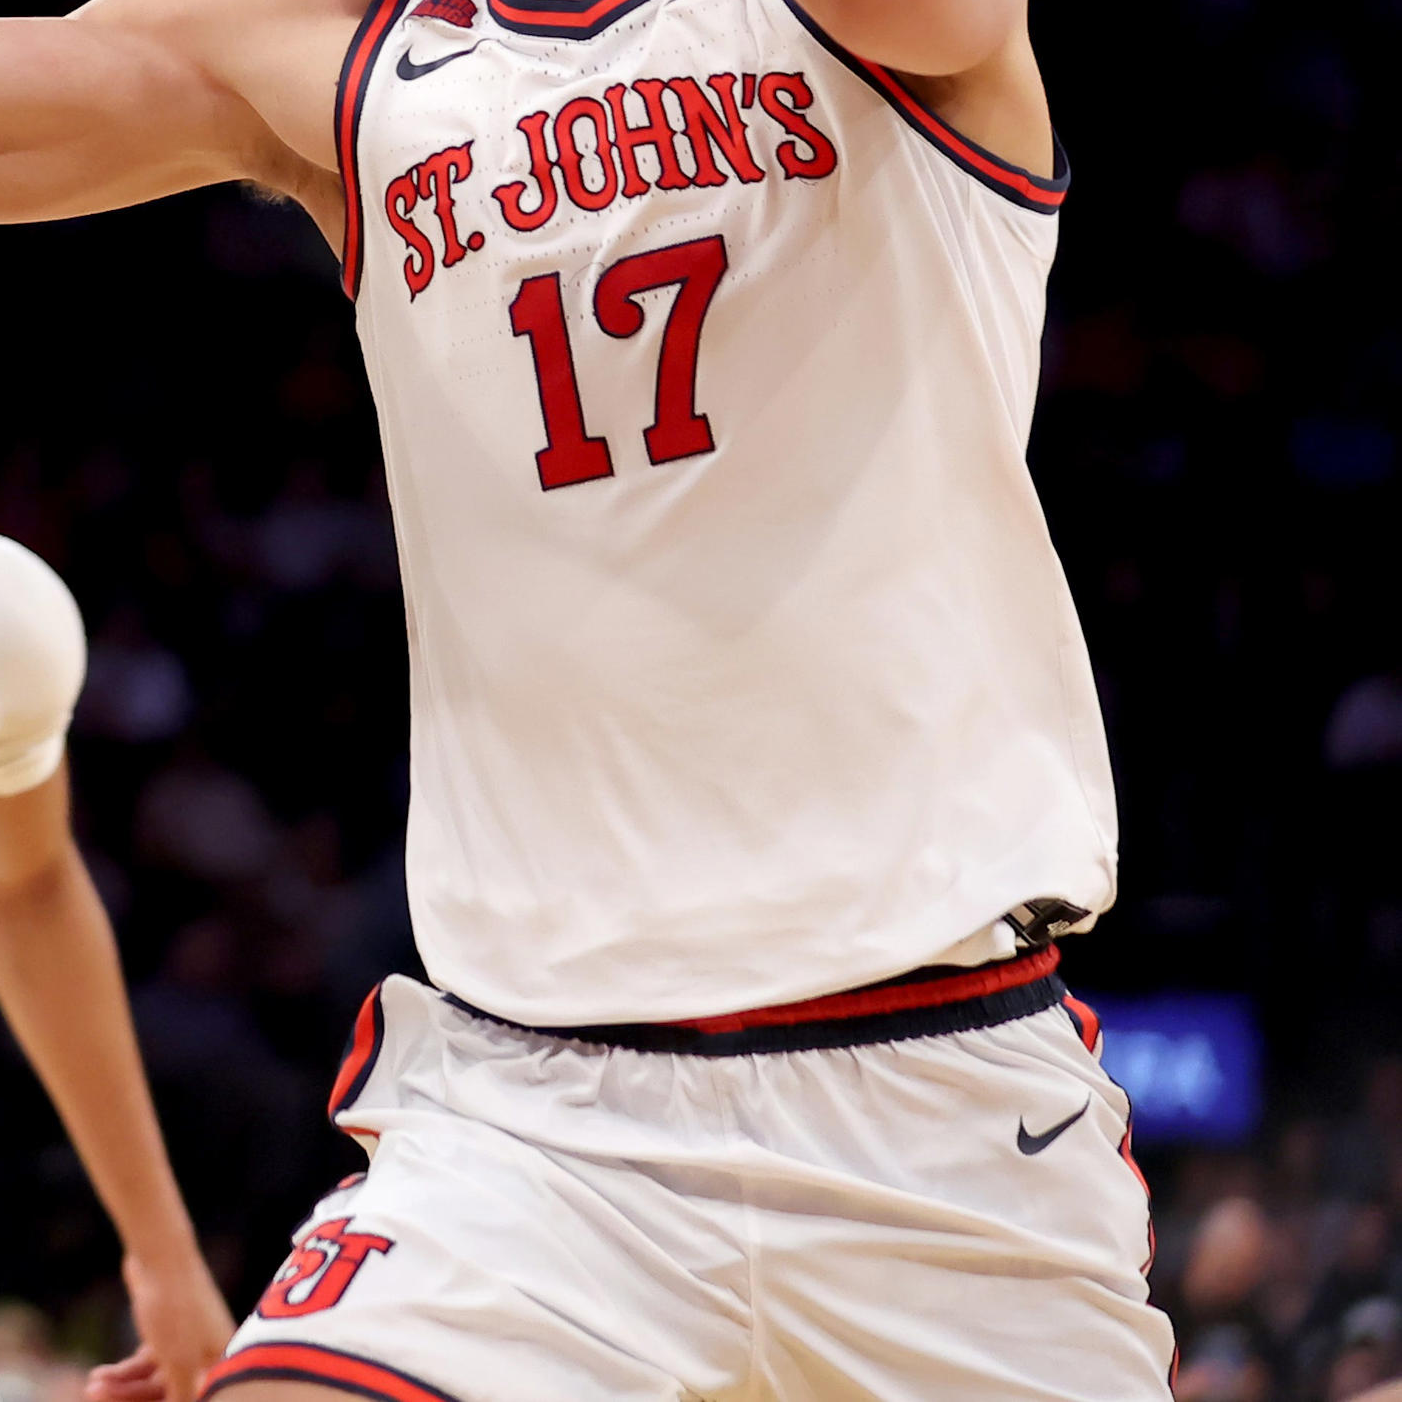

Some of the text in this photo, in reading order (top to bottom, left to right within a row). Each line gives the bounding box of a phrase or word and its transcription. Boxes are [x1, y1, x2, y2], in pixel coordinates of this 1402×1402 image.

[384, 72, 838, 303] ST. JOHN'S
[508, 234, 729, 491] 17
